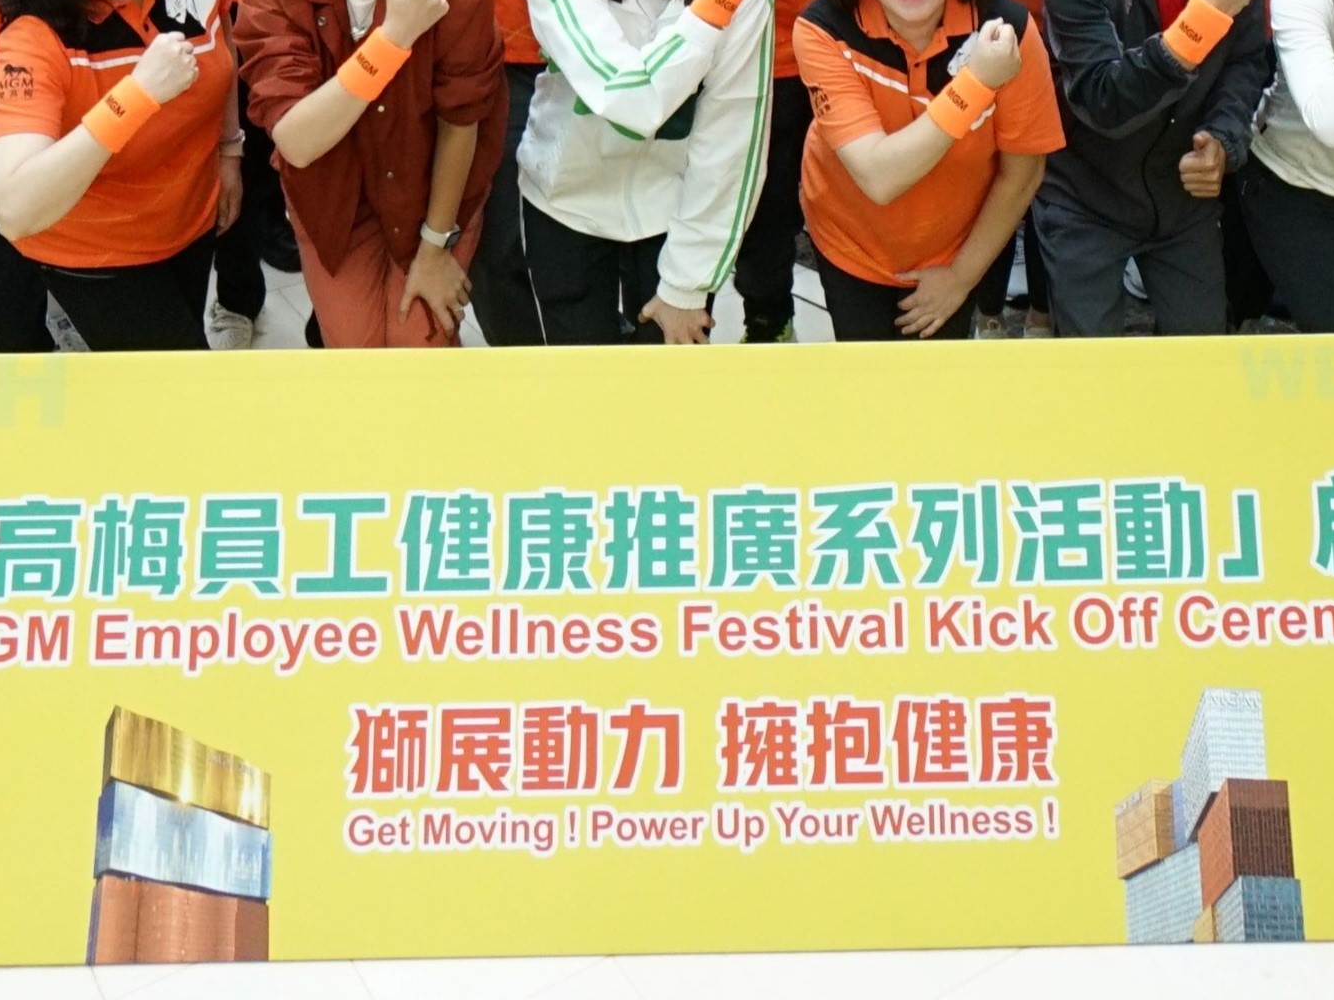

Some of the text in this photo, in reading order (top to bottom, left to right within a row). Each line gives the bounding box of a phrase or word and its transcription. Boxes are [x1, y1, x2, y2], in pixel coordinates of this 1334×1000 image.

[1178, 21, 1202, 43] MGM
[355, 52, 378, 76] MGM
[0, 77, 34, 89] MGM
[105, 94, 125, 118] MGM
[946, 87, 967, 111] MGM
[94, 610, 377, 670] Employee
[400, 606, 659, 657] Wellness
[682, 602, 905, 652] Festival
[929, 600, 1053, 647] Kick
[1073, 596, 1157, 645] Off
[351, 698, 1054, 793] 獅展動力 擁抱健康
[349, 815, 408, 846] Get
[422, 813, 554, 851] Moving
[591, 810, 703, 842] Power
[716, 808, 765, 847] Up
[776, 806, 859, 839] Your
[869, 803, 1033, 837] Wellness
